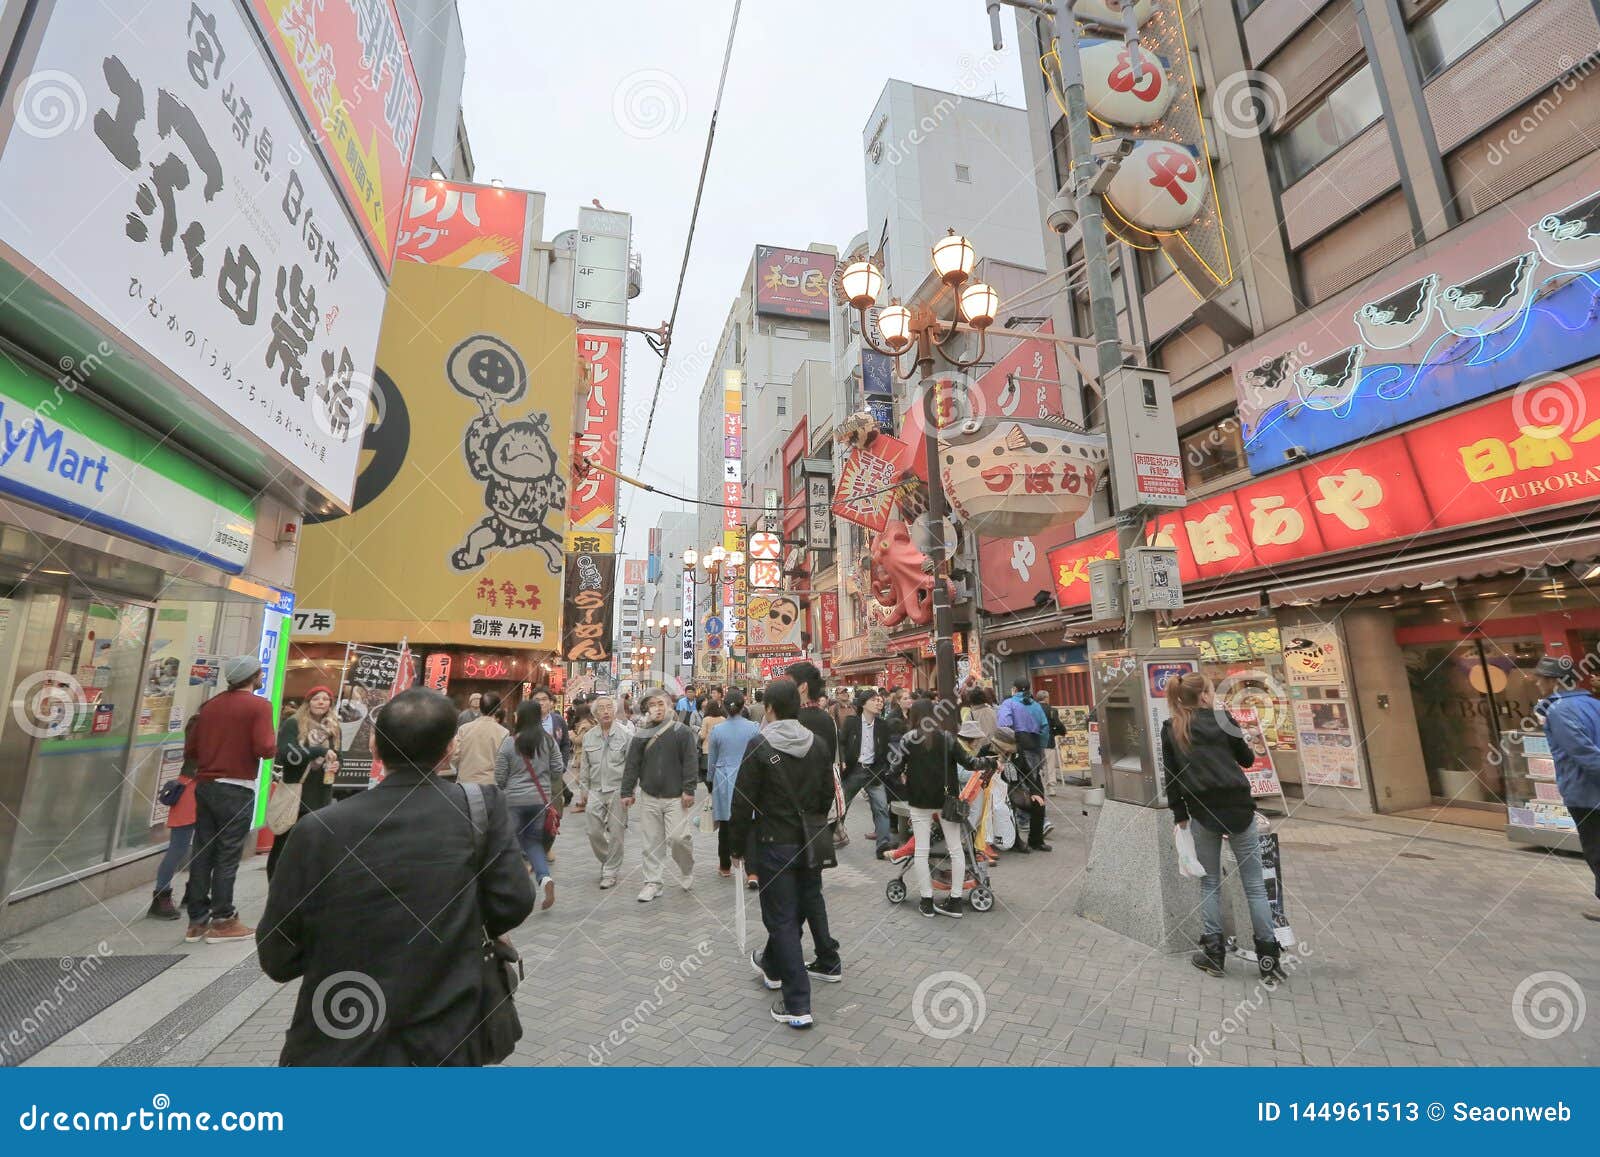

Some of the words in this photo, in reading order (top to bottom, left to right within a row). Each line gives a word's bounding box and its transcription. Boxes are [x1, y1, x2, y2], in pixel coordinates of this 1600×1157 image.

[580, 234, 596, 243] 5F
[578, 267, 594, 276] 4F
[576, 300, 592, 310] 3F
[1147, 467, 1384, 566] ぼらや
[751, 533, 780, 587] 大阪
[477, 577, 542, 610] 薩摩っ子
[472, 617, 503, 638] 創業
[507, 621, 543, 639] 47年
